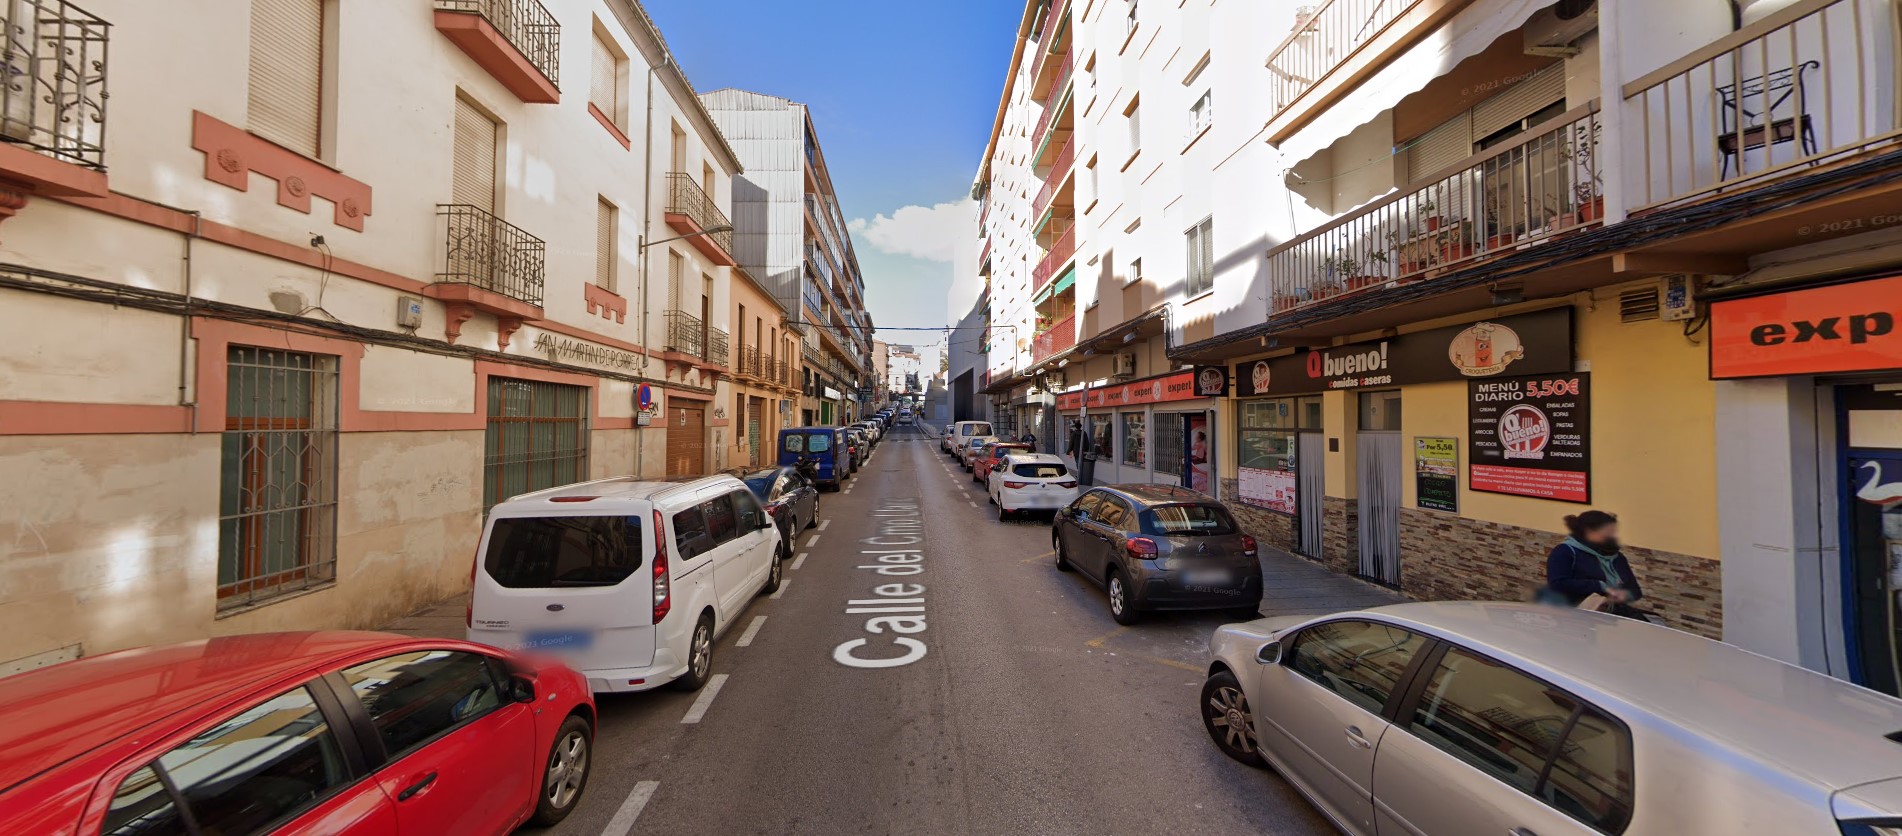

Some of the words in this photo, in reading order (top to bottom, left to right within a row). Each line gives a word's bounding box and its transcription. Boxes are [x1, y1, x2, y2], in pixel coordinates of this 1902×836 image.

[1750, 311, 1894, 346] exp
[534, 332, 557, 354] SAN
[1324, 341, 1388, 377] bueno!
[1134, 386, 1152, 397] expert
[1168, 380, 1192, 393] expert
[1328, 377, 1358, 388] comidas
[1360, 374, 1392, 386] caseras
[1478, 380, 1519, 393] MENÚ
[1526, 378, 1579, 399] 5,50€
[1475, 391, 1524, 402] DIARIO
[1504, 419, 1545, 442] bueno!
